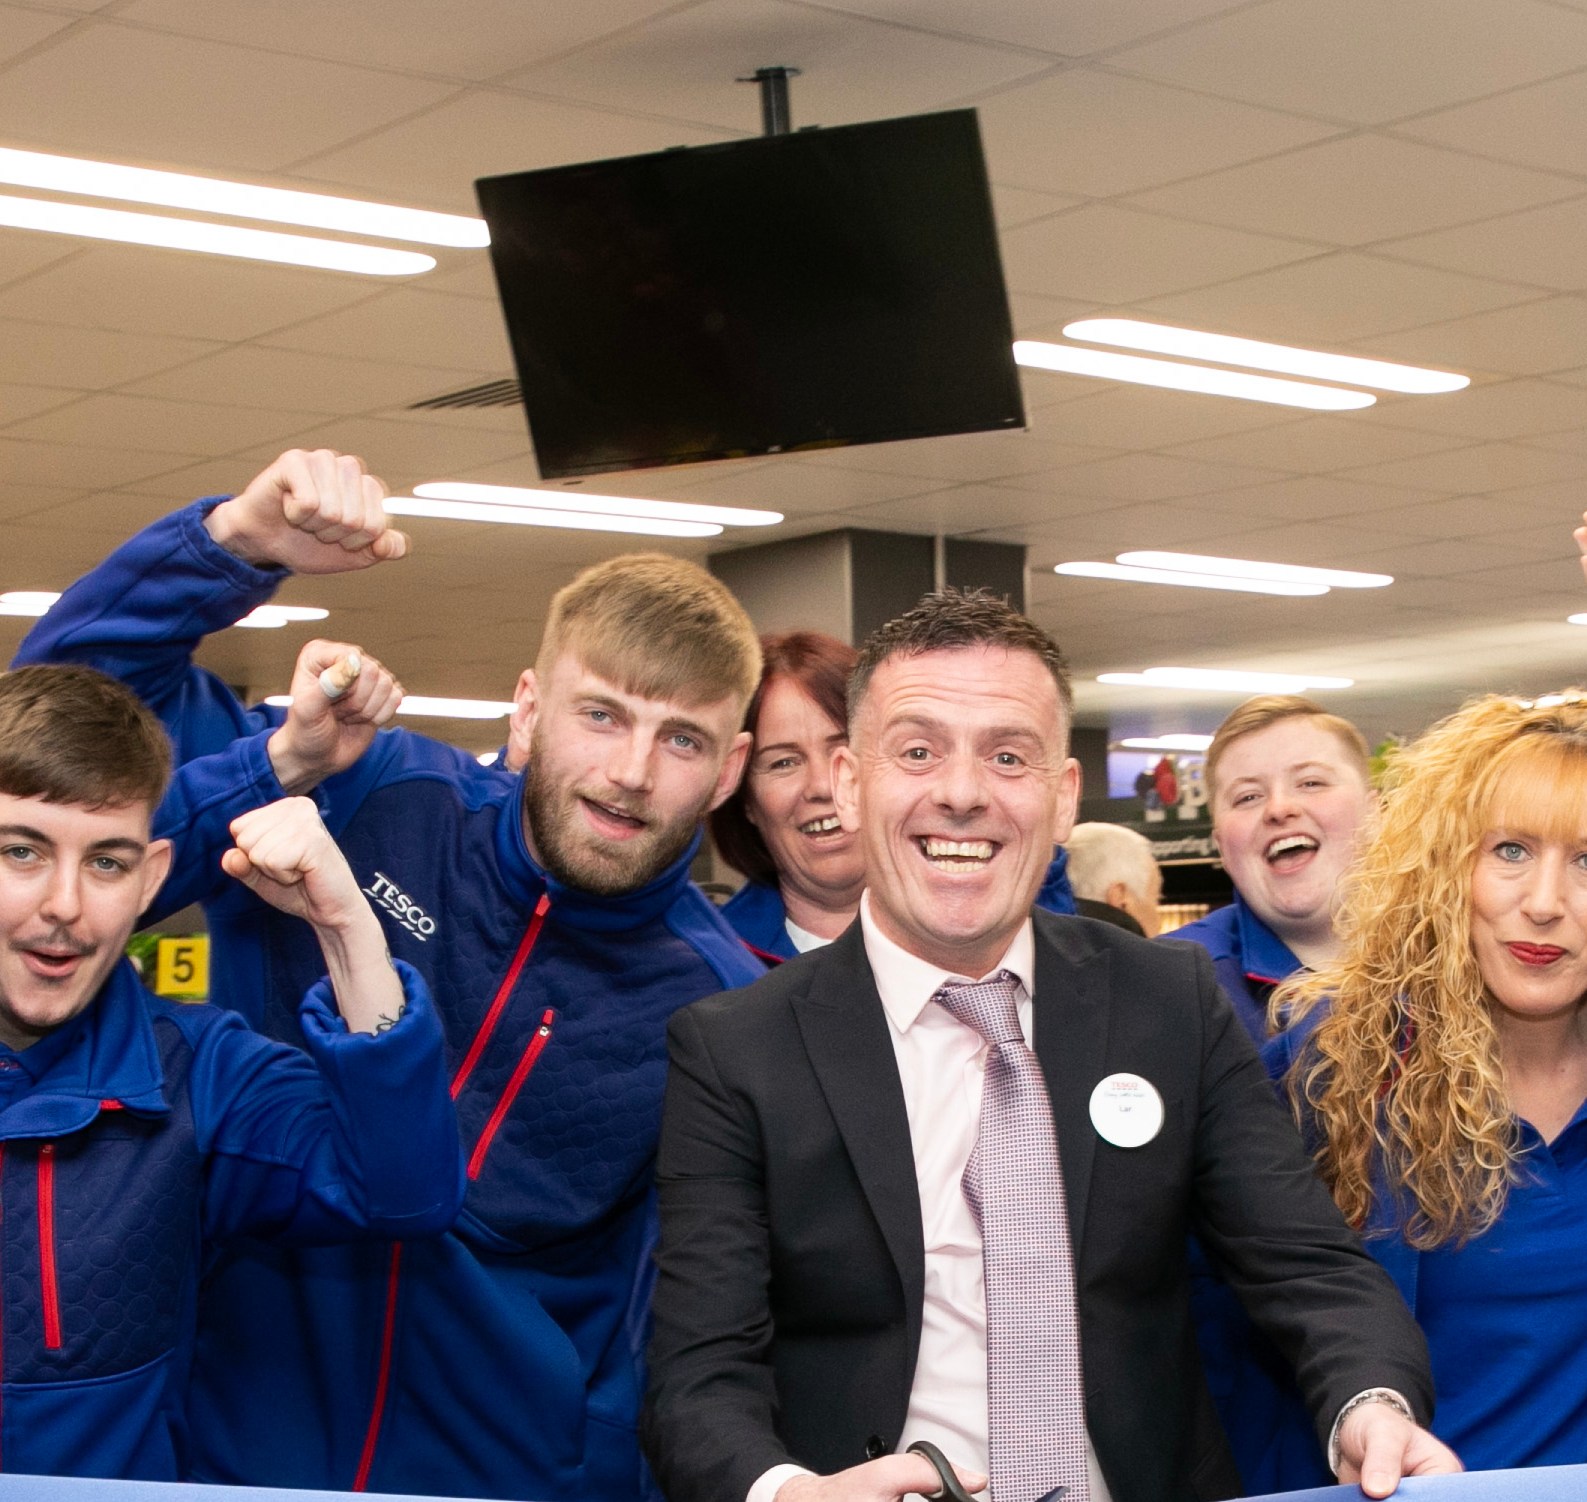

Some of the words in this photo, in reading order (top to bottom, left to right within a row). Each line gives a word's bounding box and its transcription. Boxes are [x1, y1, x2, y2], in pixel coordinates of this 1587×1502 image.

[372, 872, 436, 935] TESCO
[173, 947, 194, 983] 5
[1111, 1081, 1139, 1089] TESCO
